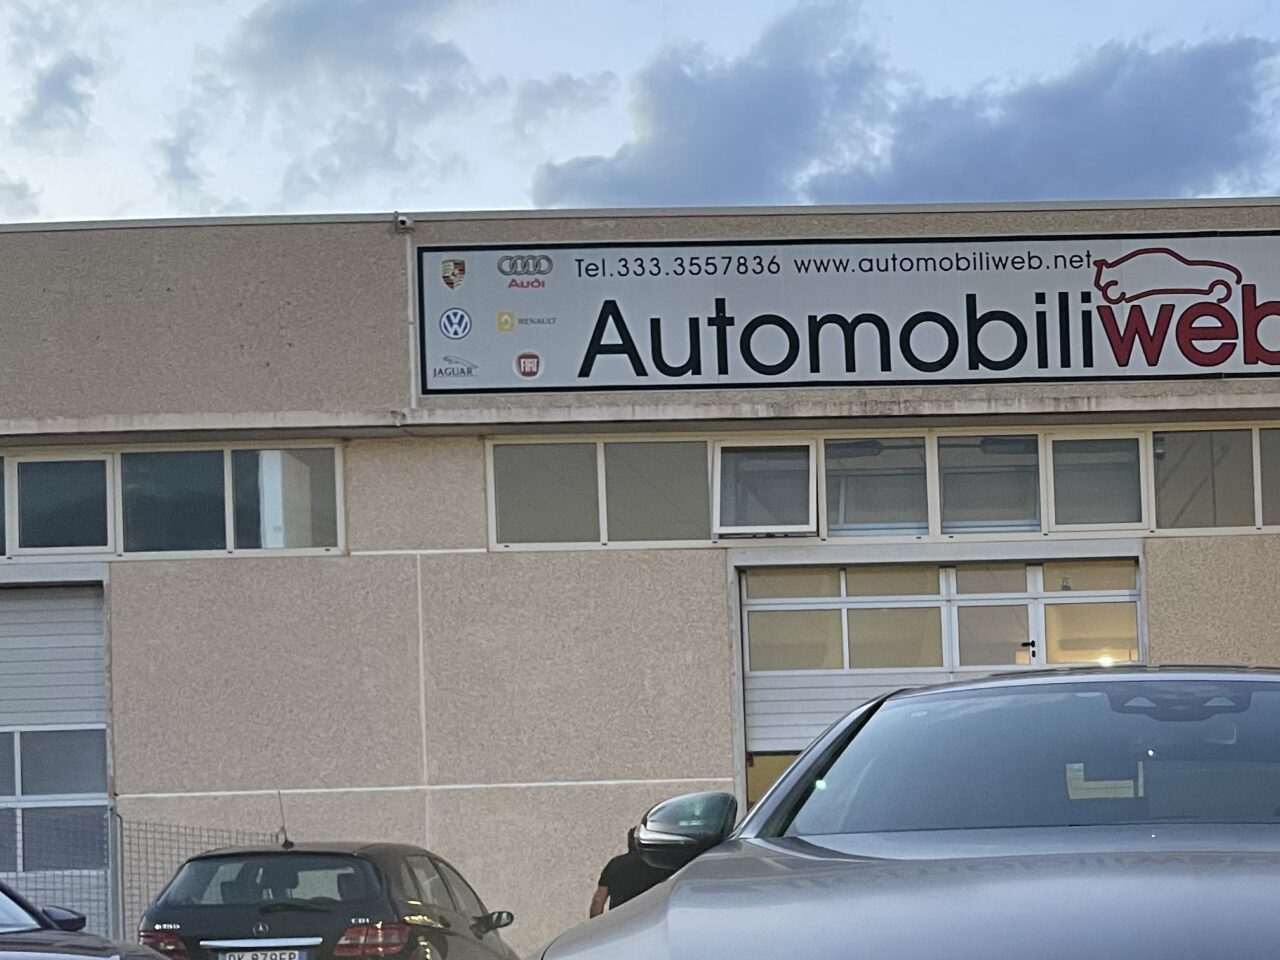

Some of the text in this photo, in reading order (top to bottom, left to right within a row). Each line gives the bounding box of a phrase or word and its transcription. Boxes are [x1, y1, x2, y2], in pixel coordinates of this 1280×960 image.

[575, 250, 1093, 278] Tel.333.3557836 www.automobiliweb.net
[433, 368, 473, 378] JAGUAR
